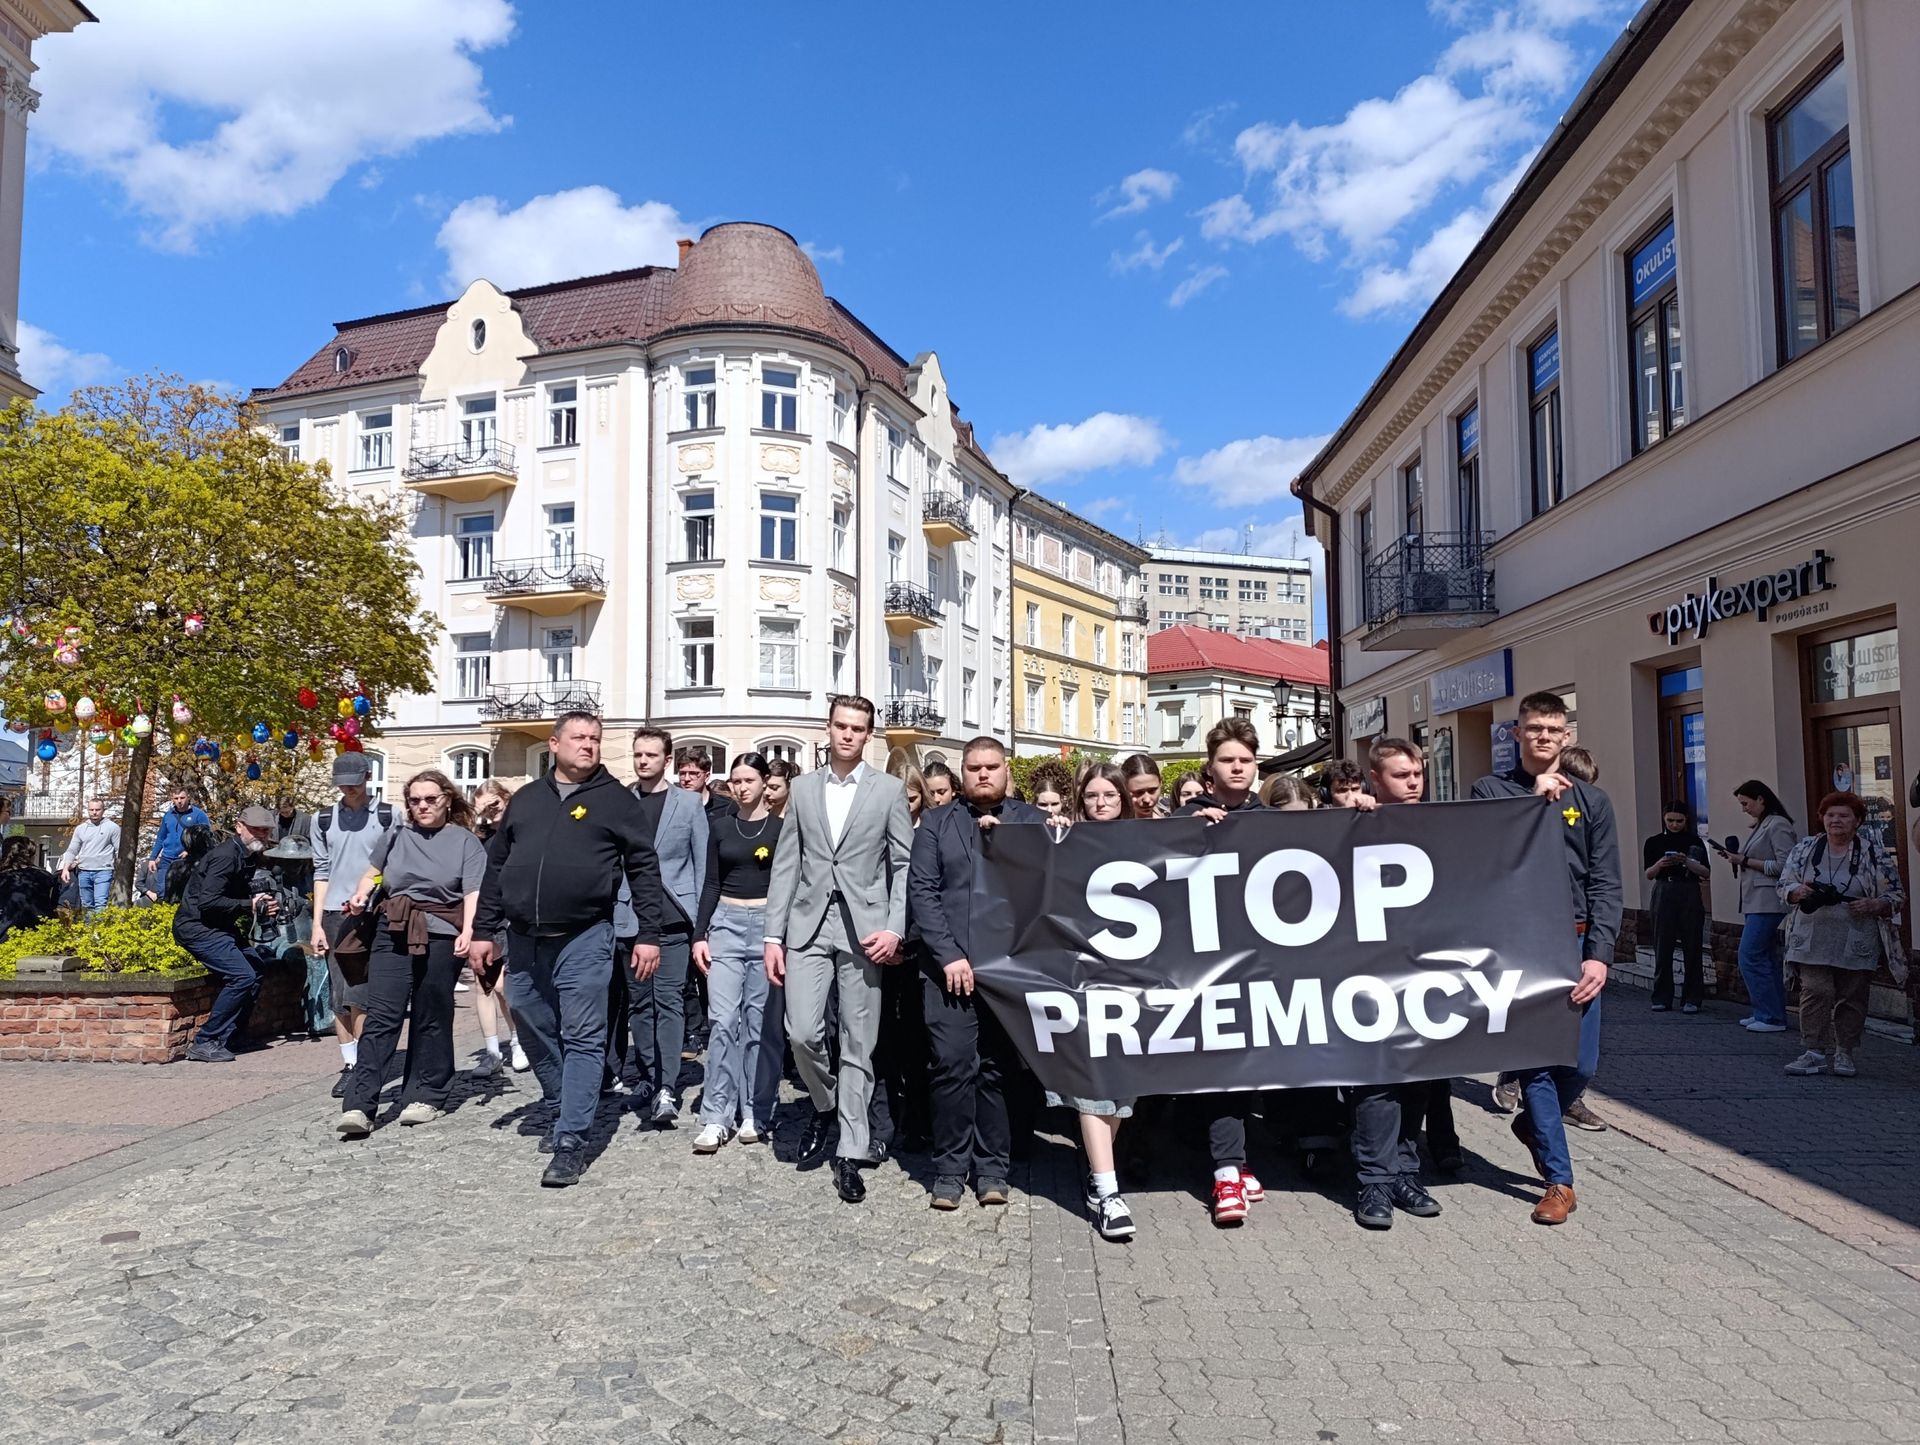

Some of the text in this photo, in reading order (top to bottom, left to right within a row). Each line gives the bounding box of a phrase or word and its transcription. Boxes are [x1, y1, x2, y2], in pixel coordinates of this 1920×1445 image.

[1647, 550, 1827, 645] optykexpert
[1085, 843, 1434, 961] STOP
[1025, 969, 1523, 1059] PRZEMOCY
